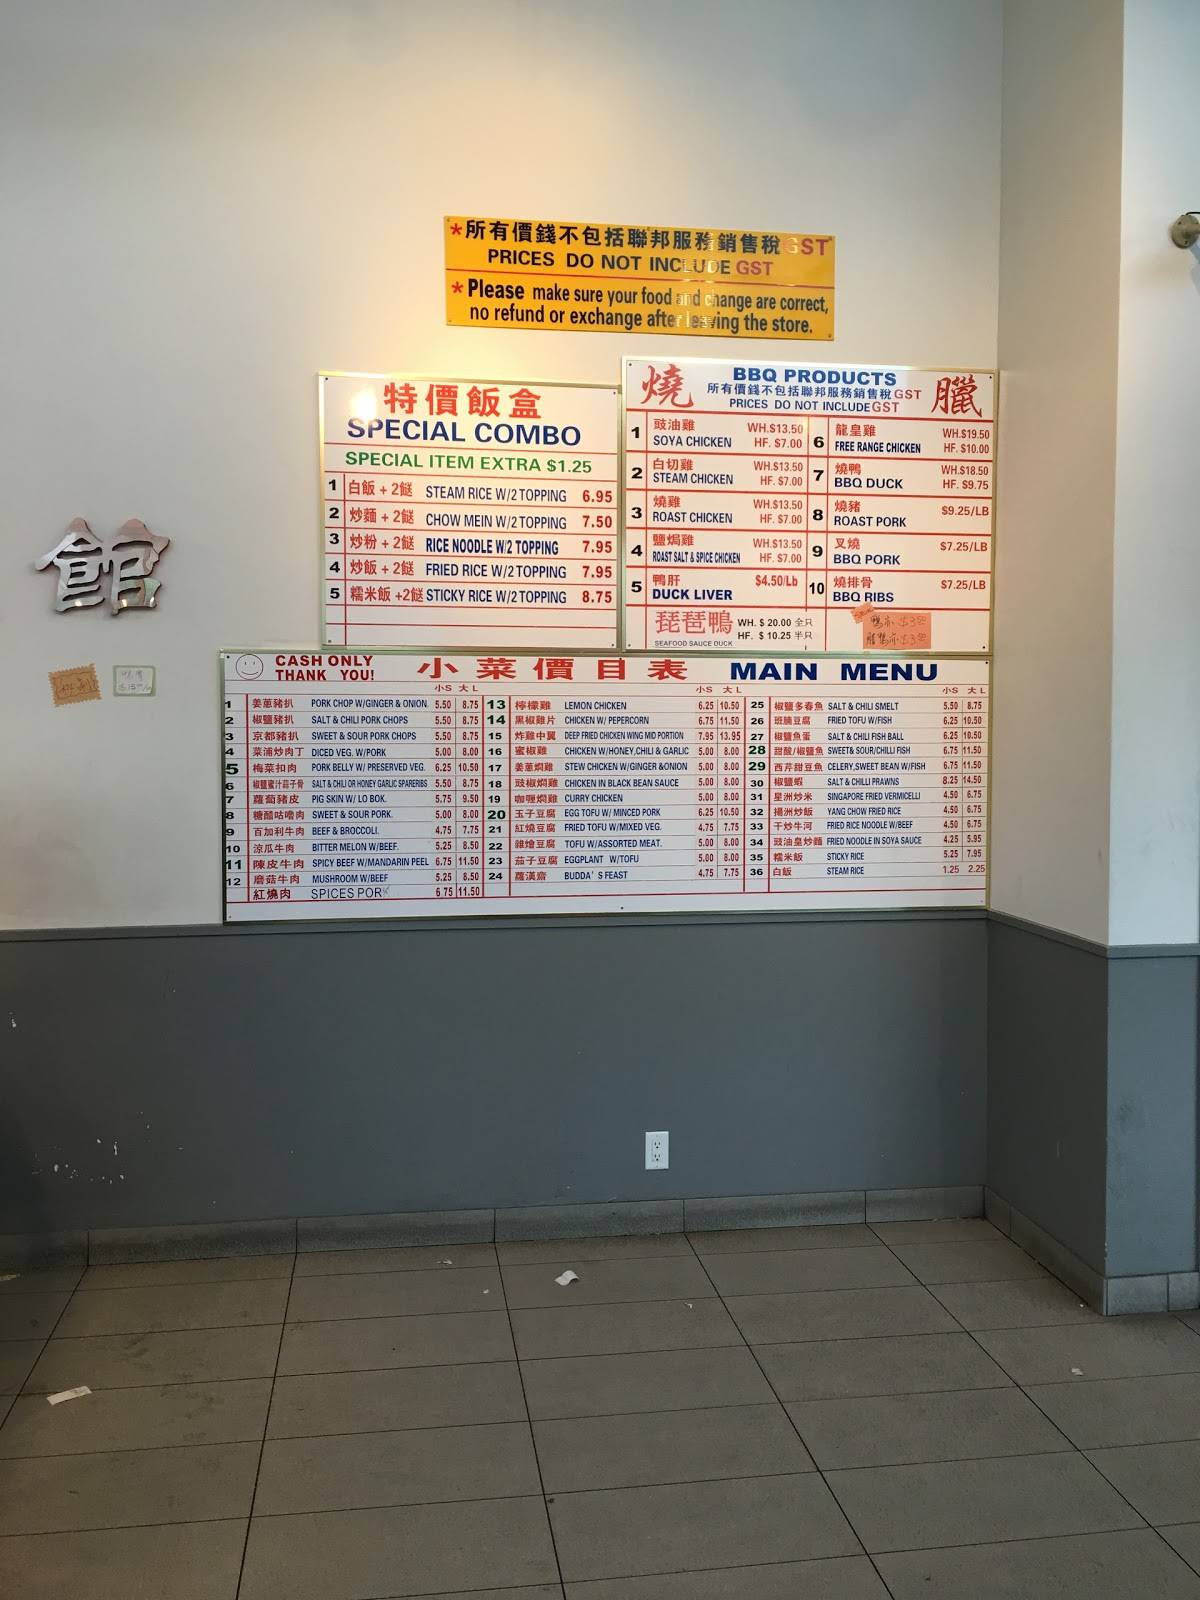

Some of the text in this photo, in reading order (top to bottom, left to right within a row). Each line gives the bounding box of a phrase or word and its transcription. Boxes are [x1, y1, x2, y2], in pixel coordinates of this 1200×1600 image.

[488, 249, 773, 276] PRICES DO NOT INCLUDE GST
[467, 278, 525, 300] Please
[533, 284, 570, 303] make
[574, 287, 603, 303] sure
[607, 289, 638, 307] your
[642, 287, 672, 305] food
[704, 290, 753, 314] change
[755, 294, 777, 311] are
[780, 294, 830, 315] correct,
[469, 306, 489, 321] no
[494, 304, 545, 323] refund
[549, 307, 565, 324] or
[570, 308, 642, 331] exchange
[647, 308, 682, 328] after
[743, 312, 768, 332] the
[772, 315, 813, 335] store.
[734, 368, 896, 387] BBQ PRODUCTS
[384, 382, 542, 420] 特價飯盒
[730, 399, 768, 408] PRICES
[775, 400, 790, 409] DO
[795, 401, 818, 410] NOT
[348, 419, 580, 446] SPECIAL COMBO
[632, 427, 802, 448] 1 SOYA CHICKEN HF. $7.00
[814, 437, 989, 453] 6 FREE RANGE CHICKEN HF. $10.00
[346, 452, 591, 473] SPECIAL ITEM EXTRA $1.25
[835, 463, 861, 475] 燒鴨
[814, 470, 902, 488] 7 BBQ DUCK
[329, 480, 336, 490] 1
[349, 480, 375, 495] 白飯
[426, 486, 464, 499] STEAM
[469, 487, 492, 500] RICE
[583, 490, 612, 502] 6.95
[813, 509, 906, 527] 8 ROAST PORK
[942, 506, 989, 516] $9.25/LB
[330, 533, 612, 555] 3 炒粉 RICE NOODLE W/2 TOPPING 7.95
[34, 516, 171, 617] 館
[330, 559, 612, 578] 4 炒飯 FRIED RICE 7.95
[756, 575, 797, 586] $4.50/Lb
[330, 586, 612, 603] 5 糯米飯 STICKY RICE 8.75
[632, 581, 732, 600] 5 DUCK LIVER
[276, 655, 373, 666] CASH ONLY
[275, 670, 374, 681] THANK YOU!
[731, 663, 937, 681] MAIN MENU
[487, 715, 505, 724] 14
[565, 716, 595, 724] CHICKEN
[609, 716, 649, 724] PEPERCORN
[699, 717, 713, 725] 6.75
[720, 717, 739, 725] 11.50
[312, 732, 337, 740] SWEET
[340, 732, 345, 740] &
[347, 732, 368, 740] SOUR
[370, 732, 389, 740] PORK
[392, 732, 416, 740] CHOPS
[435, 732, 451, 740] 5.50
[463, 732, 478, 740] 8.75
[885, 792, 920, 800] VERMICELLI
[967, 790, 981, 798] 6.75
[488, 810, 505, 819] 20
[515, 809, 555, 818] 玉子豆腐
[565, 809, 579, 817] EGG
[699, 808, 713, 816] 6.25
[720, 808, 739, 816] 10.50
[253, 827, 304, 836] 百加利牛肉
[312, 827, 330, 835] BEEF
[436, 826, 451, 834] 4.75
[463, 826, 479, 834] 7.75
[827, 867, 849, 875] STEAM
